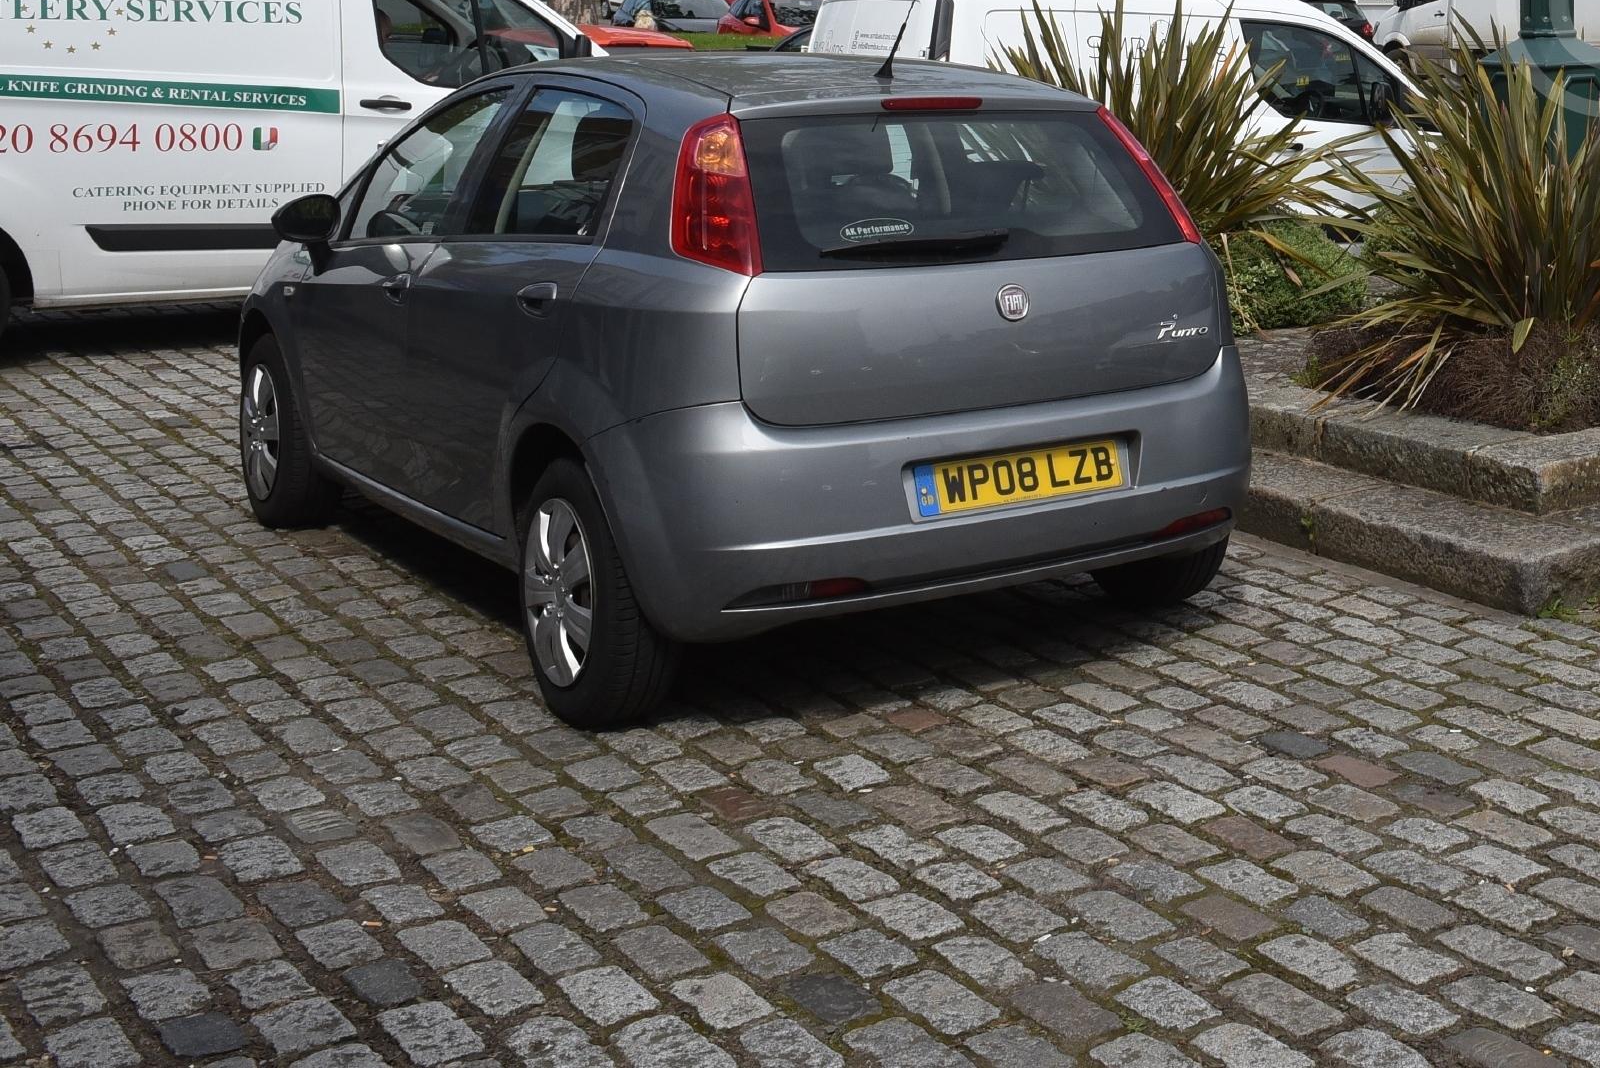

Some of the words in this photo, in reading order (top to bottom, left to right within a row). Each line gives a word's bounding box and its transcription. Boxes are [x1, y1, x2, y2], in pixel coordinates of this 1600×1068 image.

[126, 0, 303, 24] SERVICES
[8, 80, 59, 93] KNIFE
[64, 82, 148, 98] GRINDING
[152, 87, 165, 99] &
[168, 88, 231, 102] RENTAL
[234, 91, 307, 106] SERVICES
[49, 123, 140, 153] 8694
[155, 123, 243, 152] 0800
[72, 186, 154, 198] CATERING
[160, 183, 251, 197] EQUIPMENT
[255, 182, 325, 194] SUPPLIED
[123, 200, 176, 211] PHONE
[182, 199, 212, 211] FOR
[217, 198, 279, 209] DETAILS
[845, 227, 857, 236] AK
[857, 223, 909, 235] Performance
[1004, 294, 1023, 311] FIAT
[942, 457, 1039, 504] WP08
[1046, 447, 1114, 488] LZB
